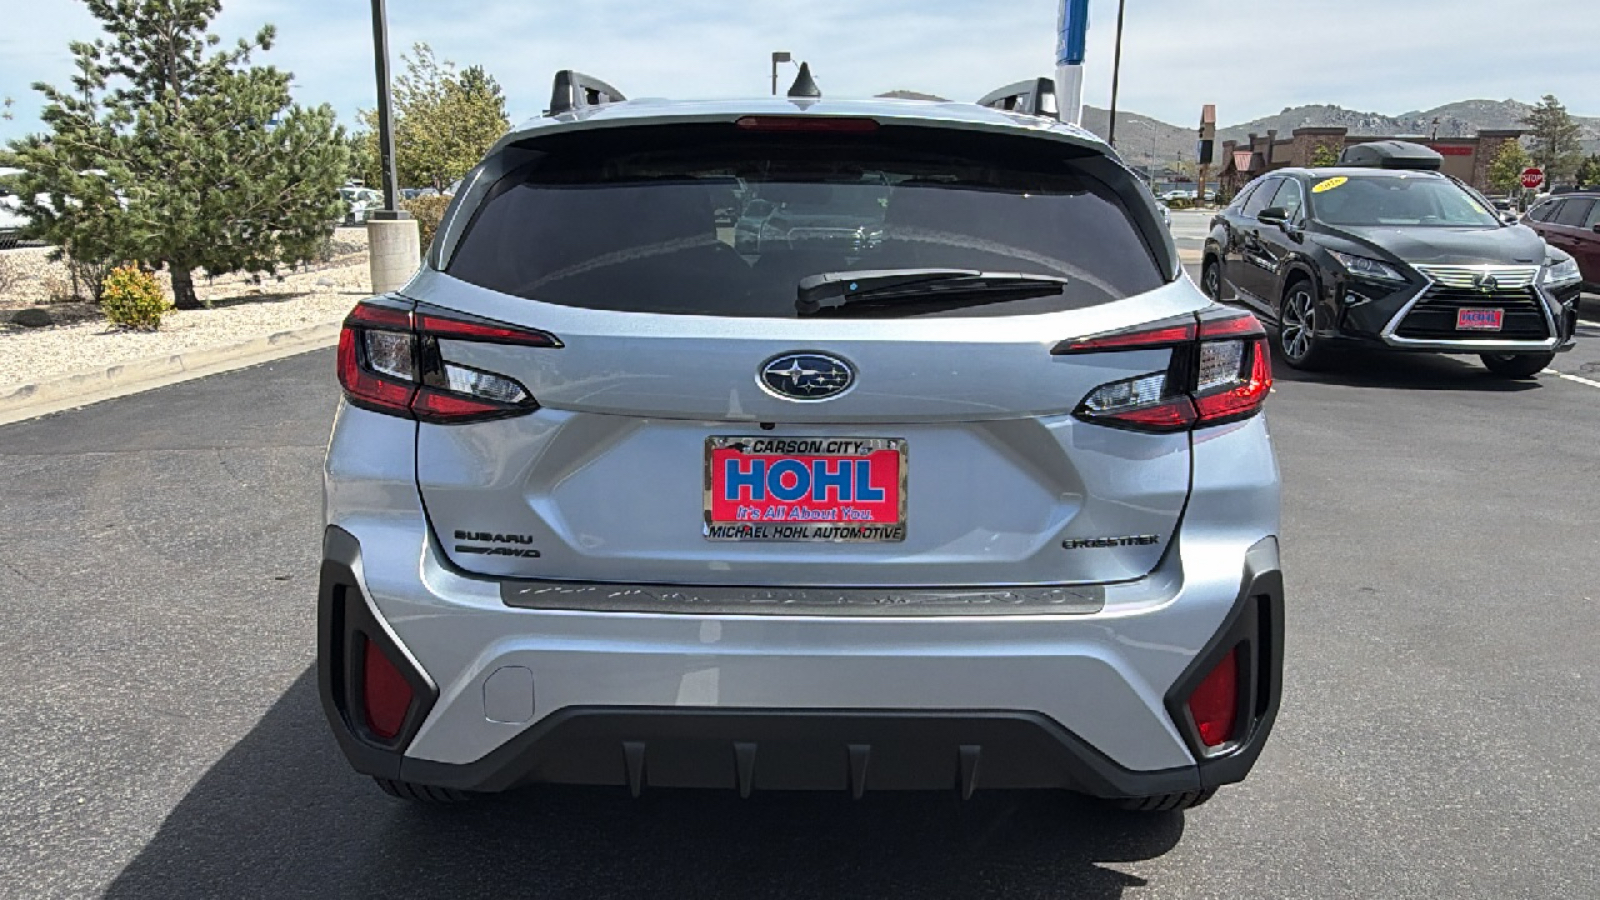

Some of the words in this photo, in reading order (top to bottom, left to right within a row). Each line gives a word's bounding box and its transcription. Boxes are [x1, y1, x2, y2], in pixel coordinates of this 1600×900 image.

[1522, 174, 1541, 183] STOP
[753, 440, 822, 454] CARSON
[824, 441, 863, 454] CITY
[725, 459, 885, 502] HOHL
[736, 505, 760, 520] It's
[764, 505, 784, 520] All
[789, 505, 837, 520] About
[841, 506, 874, 521] You.
[454, 529, 533, 545] SUBARU
[708, 525, 768, 539] MICHAEL
[773, 526, 809, 539] HOHL
[813, 526, 901, 539] AUTOMOTIVE
[1062, 534, 1160, 549] CROSSTREK
[486, 547, 541, 558] AWD
